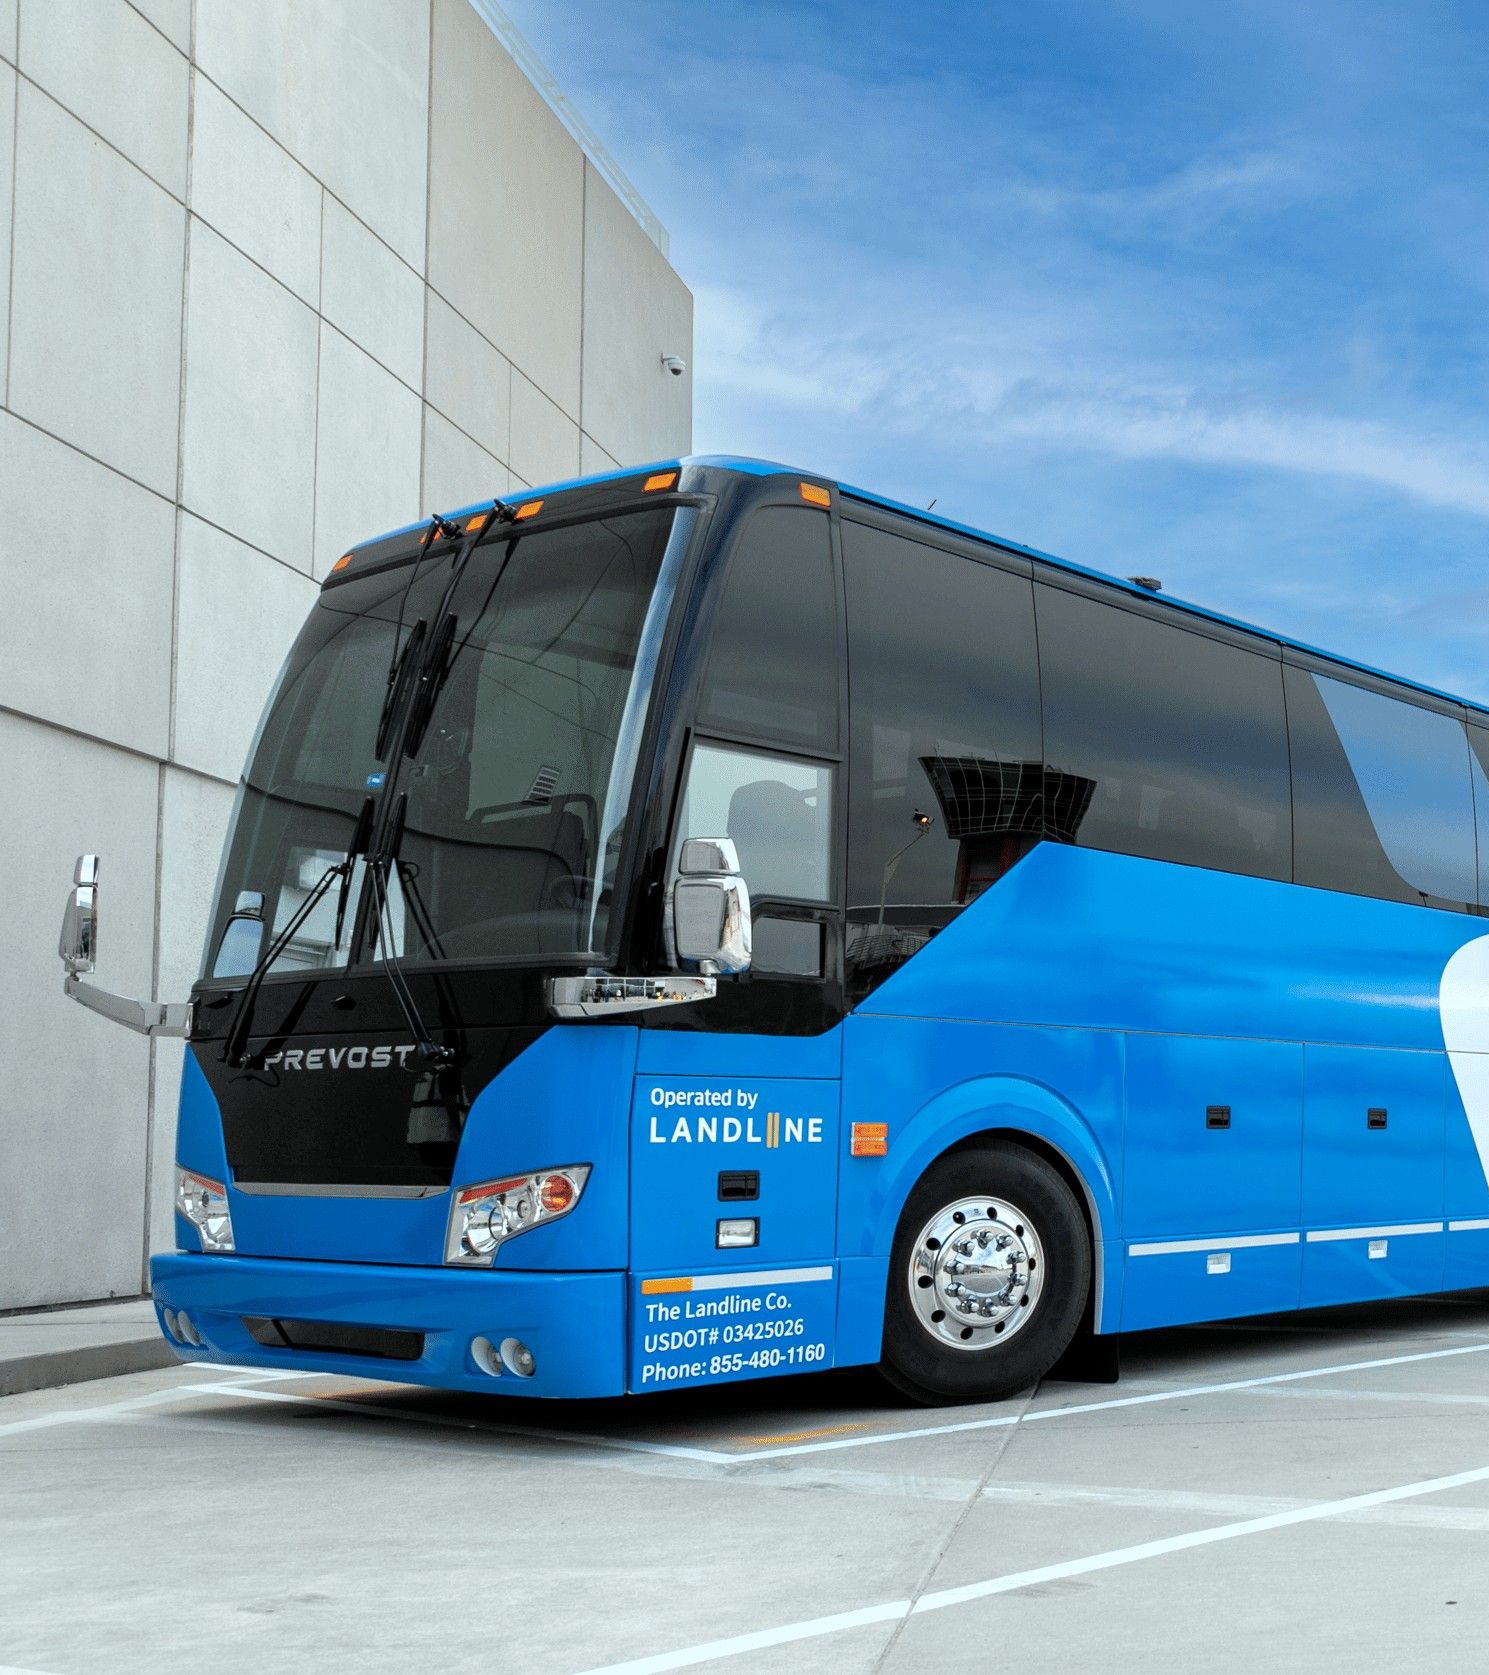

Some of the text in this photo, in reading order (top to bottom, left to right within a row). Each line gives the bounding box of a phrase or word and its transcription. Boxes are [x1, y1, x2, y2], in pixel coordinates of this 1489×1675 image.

[264, 1045, 415, 1071] PREVOST
[651, 1087, 758, 1109] Operated by
[645, 1292, 792, 1323] The Landline Co.
[644, 1318, 804, 1353] USDOT# 03425026
[641, 1342, 826, 1384] Phone: 855-480-1160
